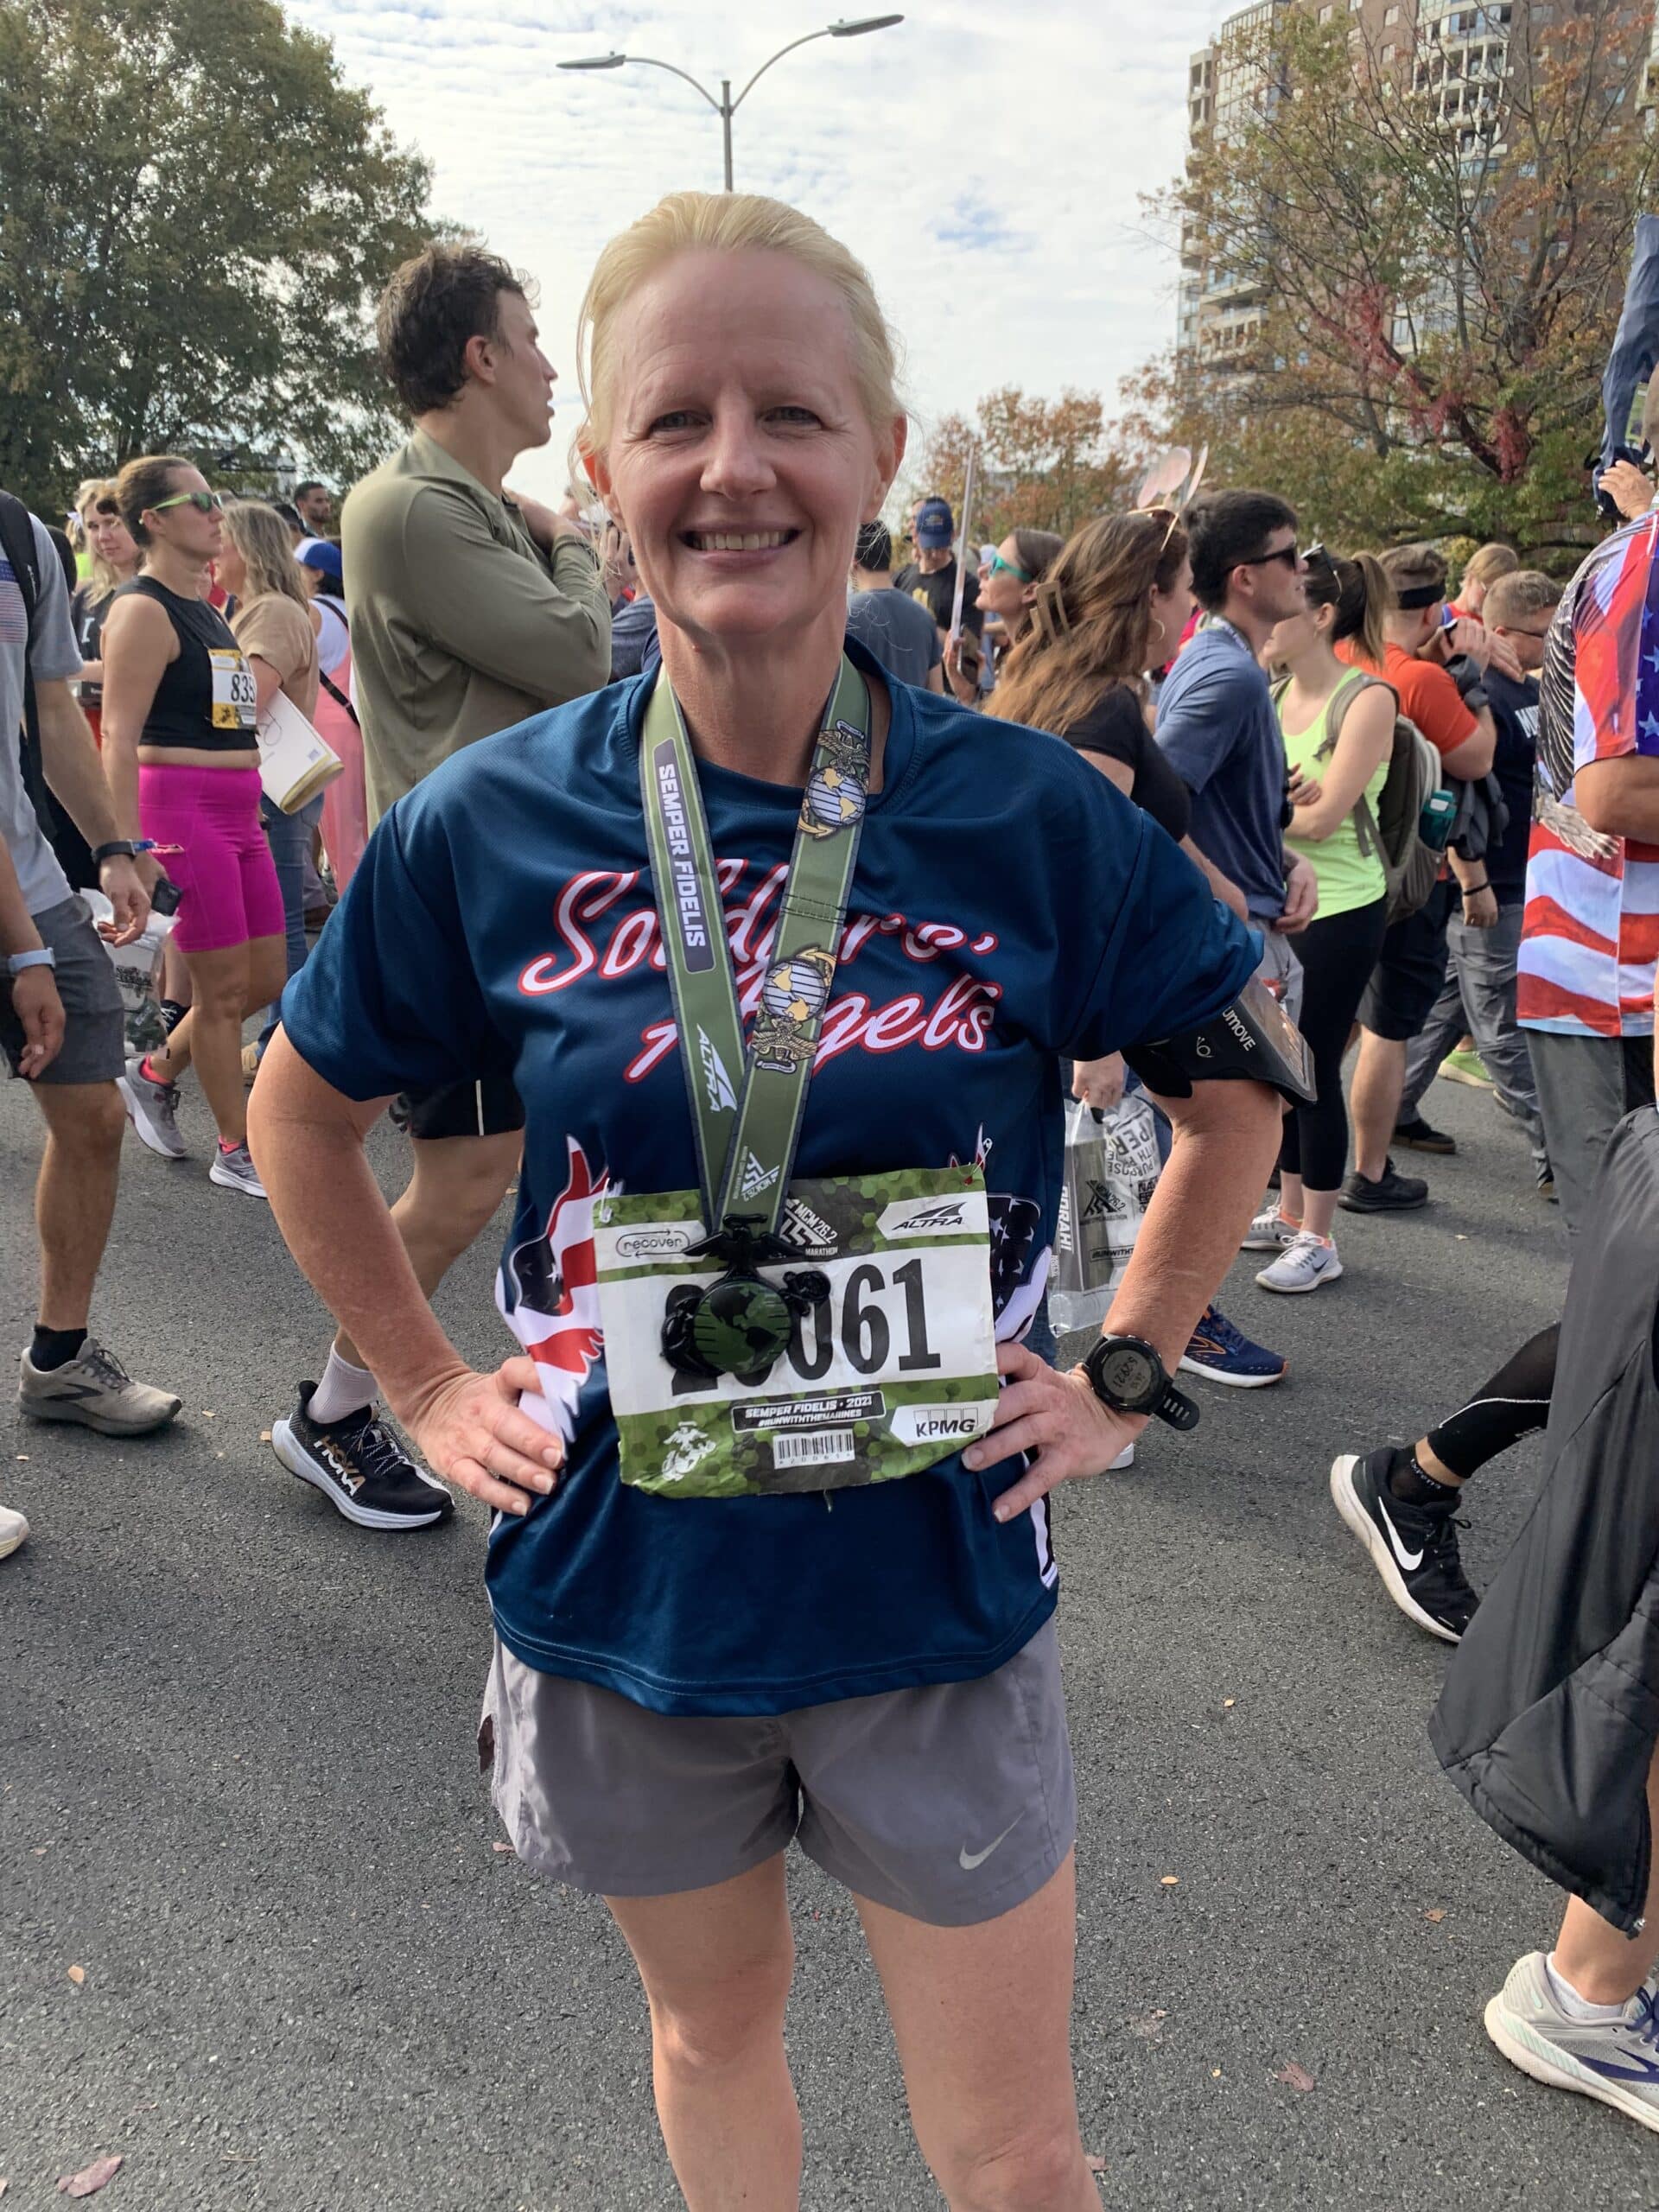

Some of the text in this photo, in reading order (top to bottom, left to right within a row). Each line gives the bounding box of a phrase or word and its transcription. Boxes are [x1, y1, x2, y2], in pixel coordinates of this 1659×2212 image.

[658, 763, 706, 948] SEMPER FIDELIS
[518, 855, 998, 995] Sodrs'
[623, 955, 1002, 1084] gels
[696, 1022, 721, 1113] ALTRA
[623, 1237, 683, 1250] recover
[794, 1203, 838, 1244] MCM26.2
[891, 1216, 963, 1231] ALTRA
[804, 1245, 839, 1256] MARATHON
[665, 1258, 942, 1396] 061
[745, 1404, 791, 1419] SEMPER
[793, 1401, 837, 1414] FIDELIS
[916, 1418, 976, 1438] KPMG
[313, 1434, 366, 1497] HOKA
